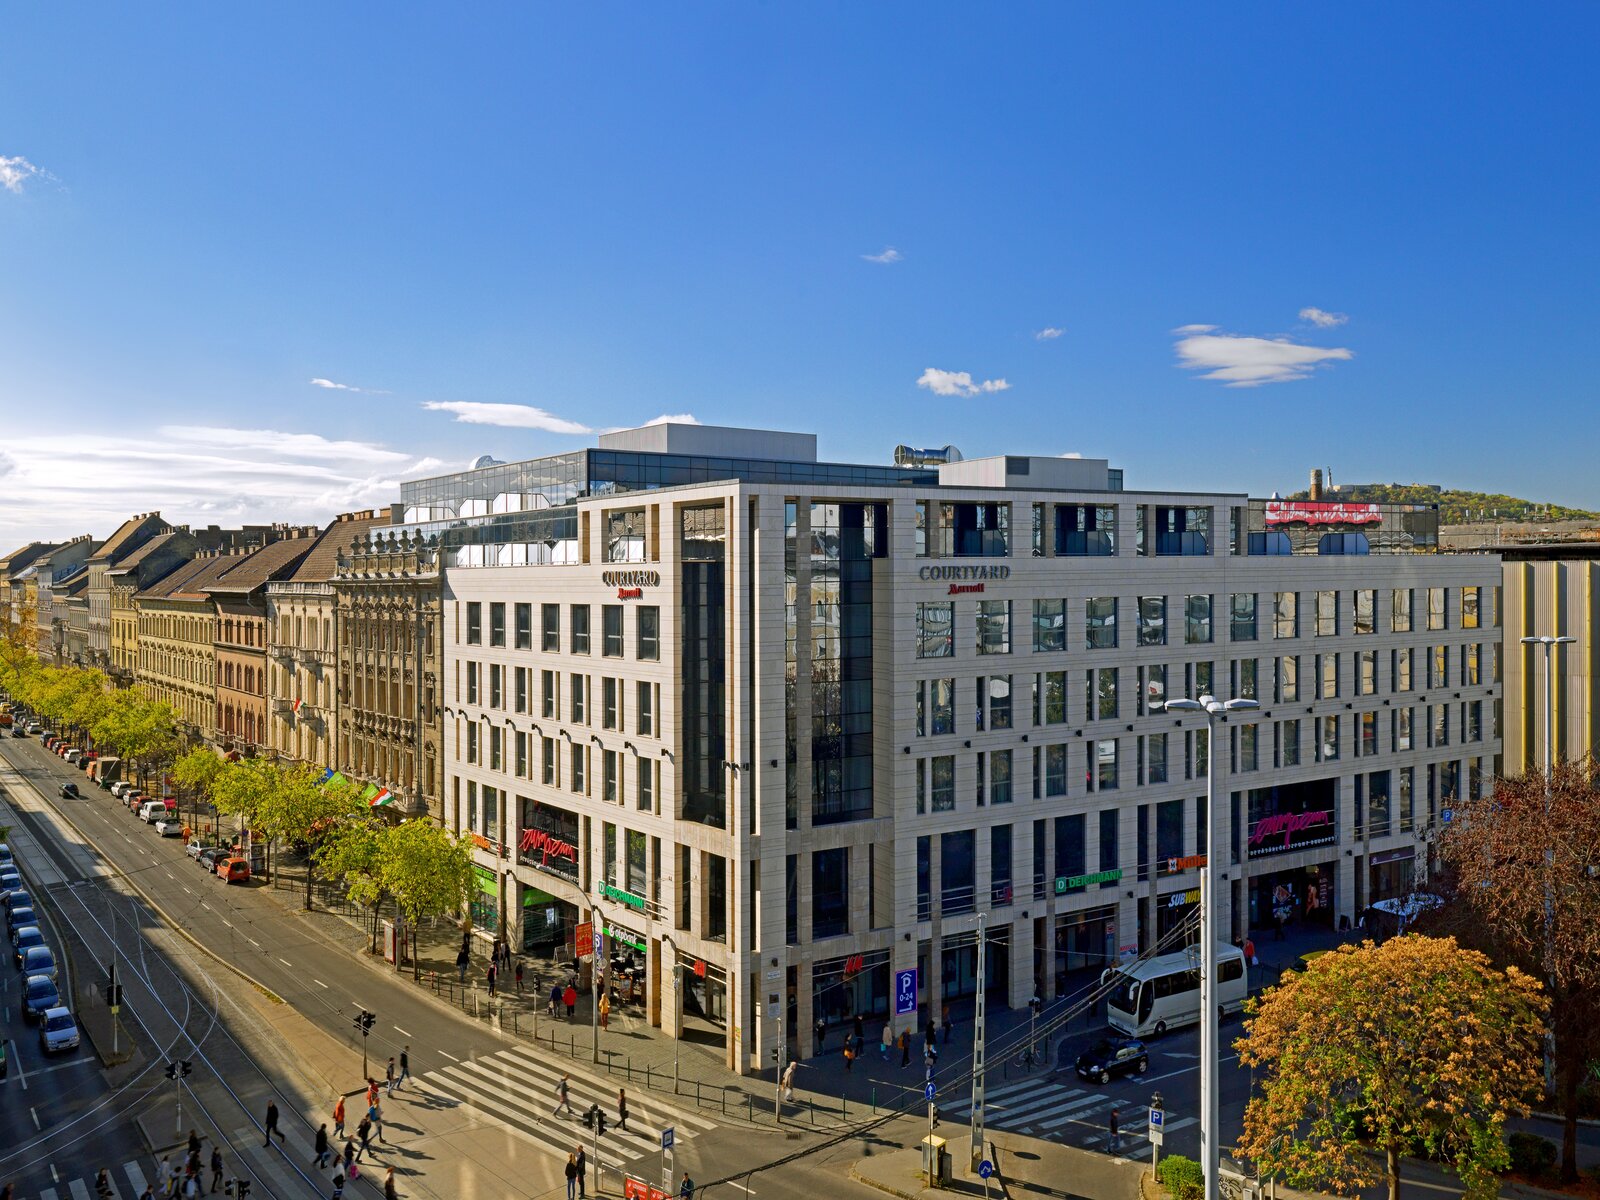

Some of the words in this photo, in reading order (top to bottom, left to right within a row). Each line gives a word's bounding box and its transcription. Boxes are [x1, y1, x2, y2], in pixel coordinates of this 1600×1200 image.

[602, 570, 659, 586] COURTYARD
[920, 565, 1011, 580] COURTYARD
[1068, 869, 1122, 888] DEICHMANN
[605, 884, 645, 909] DEICHMANN
[902, 977, 911, 993] P
[900, 992, 913, 1001] 0-24
[1152, 1112, 1160, 1122] P
